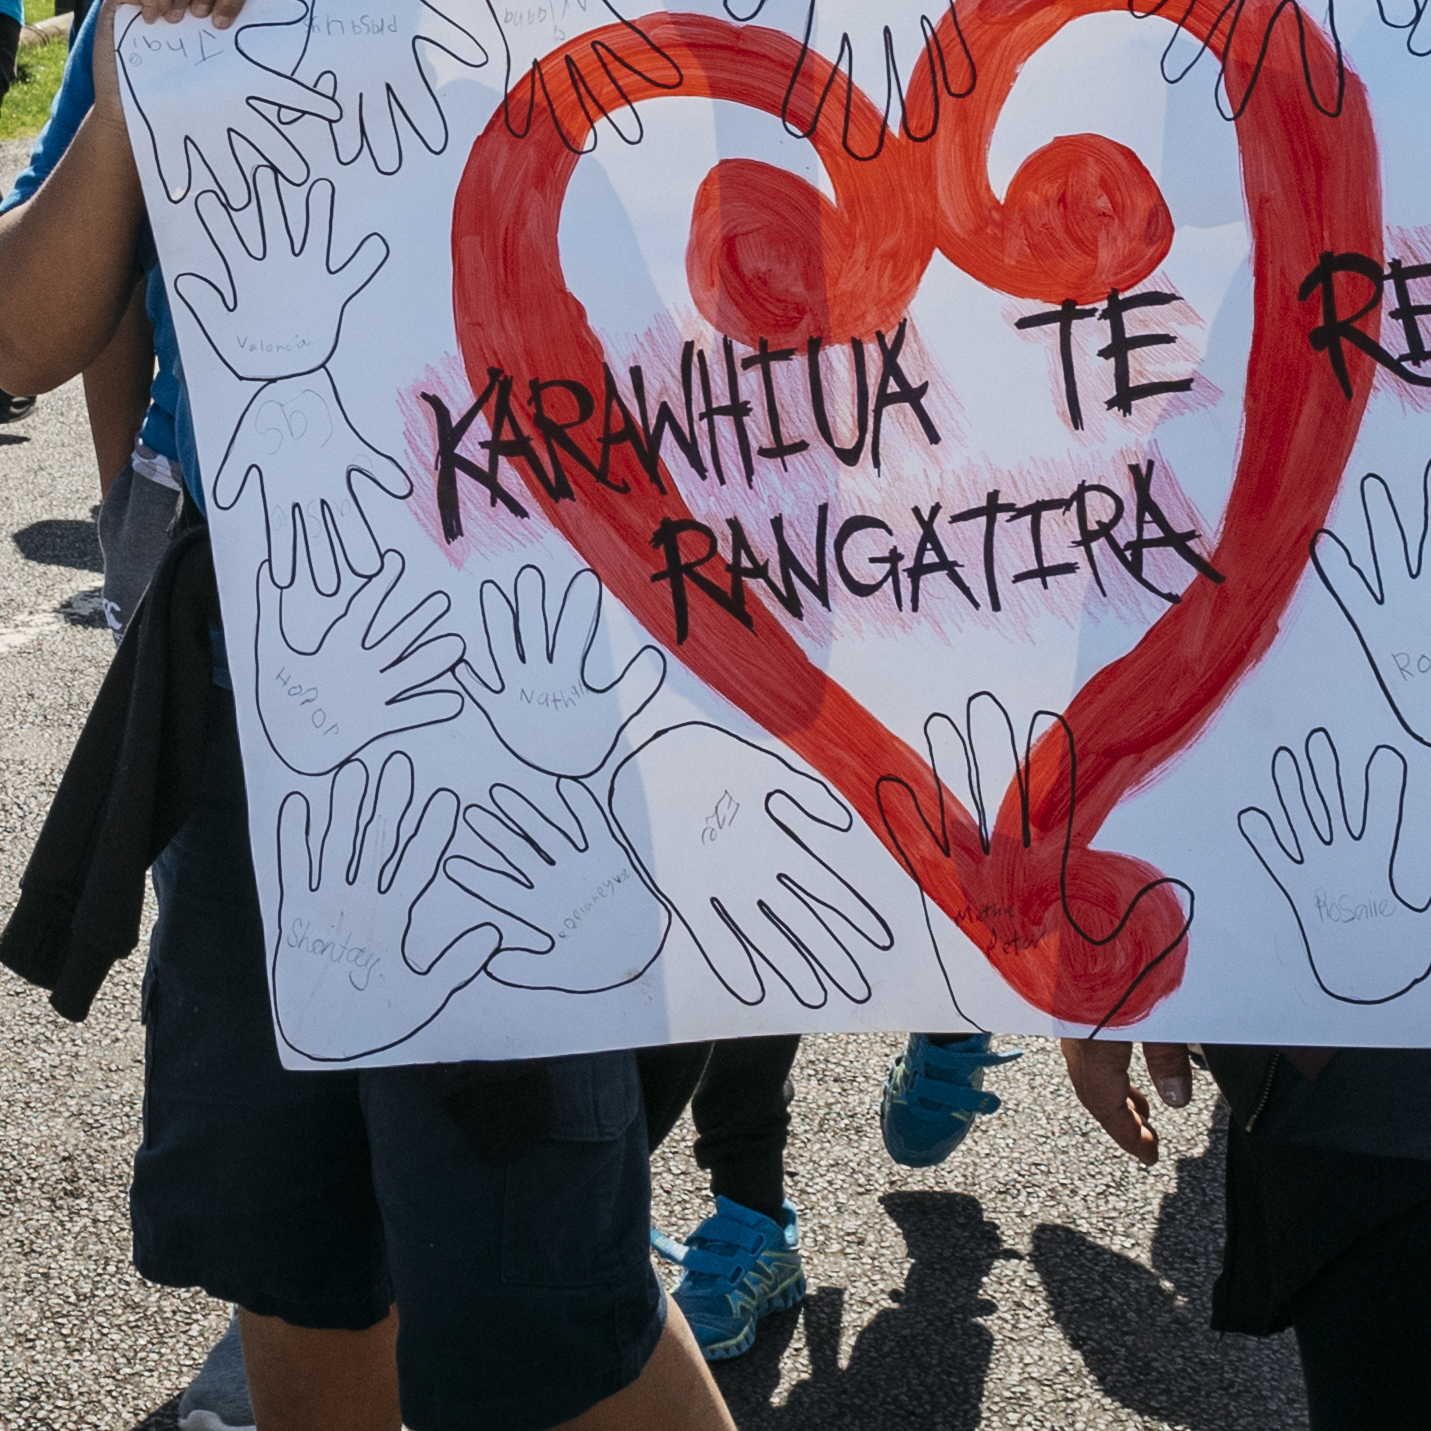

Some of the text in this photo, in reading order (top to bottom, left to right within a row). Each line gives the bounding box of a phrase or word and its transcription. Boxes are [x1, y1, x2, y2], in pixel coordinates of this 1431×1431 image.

[421, 321, 939, 543] KARAWHIUA
[1018, 289, 1193, 430] TE
[650, 460, 1226, 644] RANGATIRA
